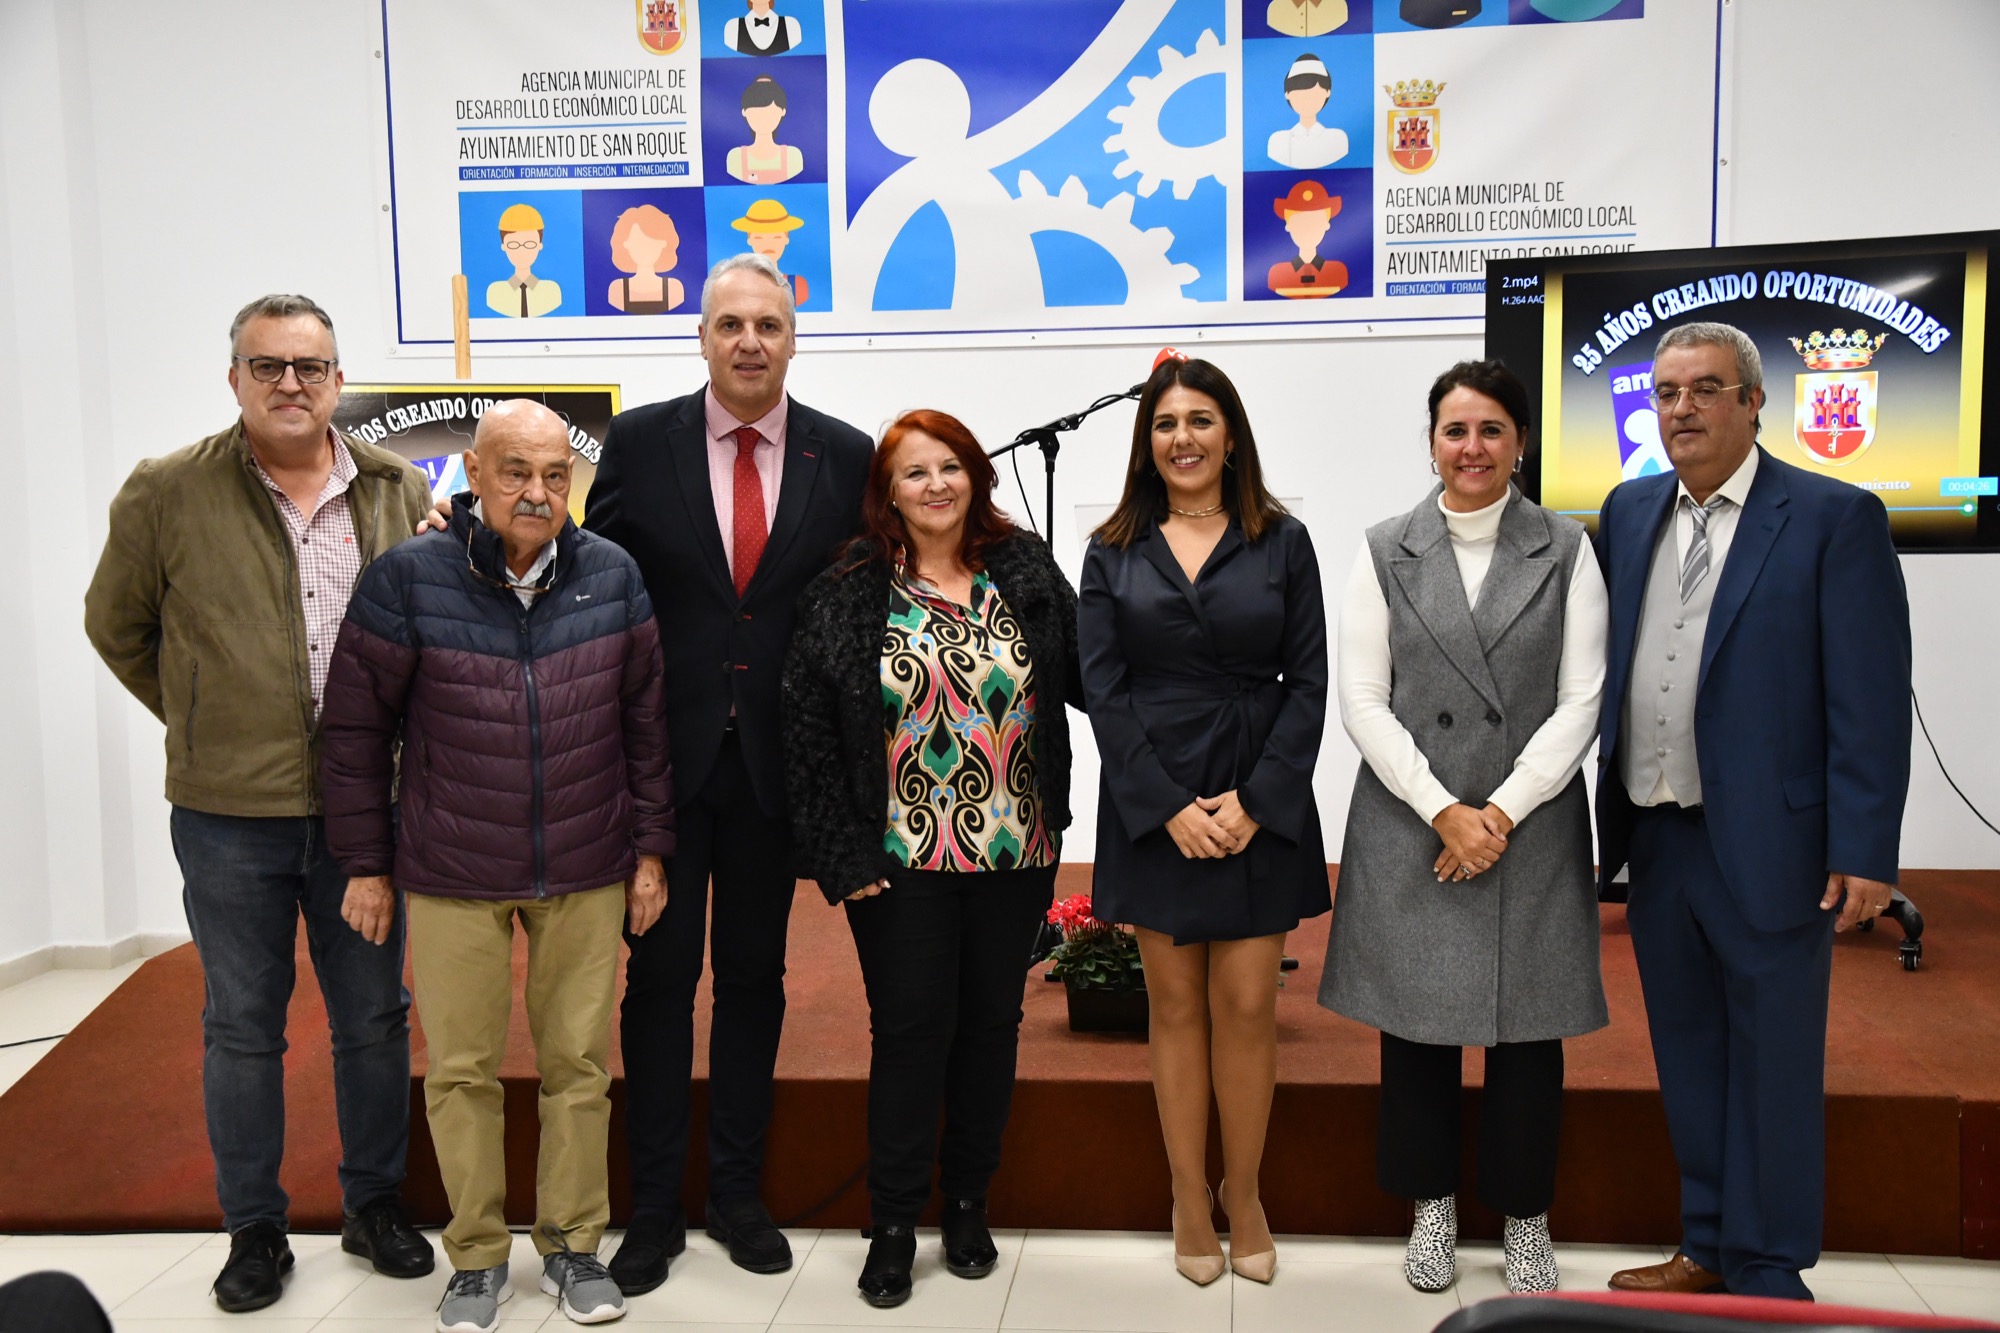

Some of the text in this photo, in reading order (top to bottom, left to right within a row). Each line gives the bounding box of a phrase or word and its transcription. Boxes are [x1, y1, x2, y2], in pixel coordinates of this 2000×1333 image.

[521, 69, 686, 92] AGENCIA MUNICIPAL DE
[456, 93, 687, 120] DESARROLLO ECONÓMICO LOCAL
[459, 131, 688, 160] AYUNTAMIENTO DE SAN ROQUE
[462, 163, 685, 179] ORIENTACIÓN FORMACIÓN INSERCIÓN INTERMEDIACIÓN
[1385, 181, 1565, 208] AGENCIA MUNICIPAL DE
[1386, 205, 1637, 235] DESARROLLO ECONÓMICO LOCAL
[1389, 280, 1487, 295] ORIENTACIÓN FORMAC
[1502, 275, 1539, 289] 2.mp4
[1502, 296, 1526, 305] H.264
[1572, 270, 1950, 375] 25 AÑOS CREANDO OPORTUNIDADES
[385, 397, 467, 432] CREANDO
[1948, 481, 1990, 492] 00:04:26
